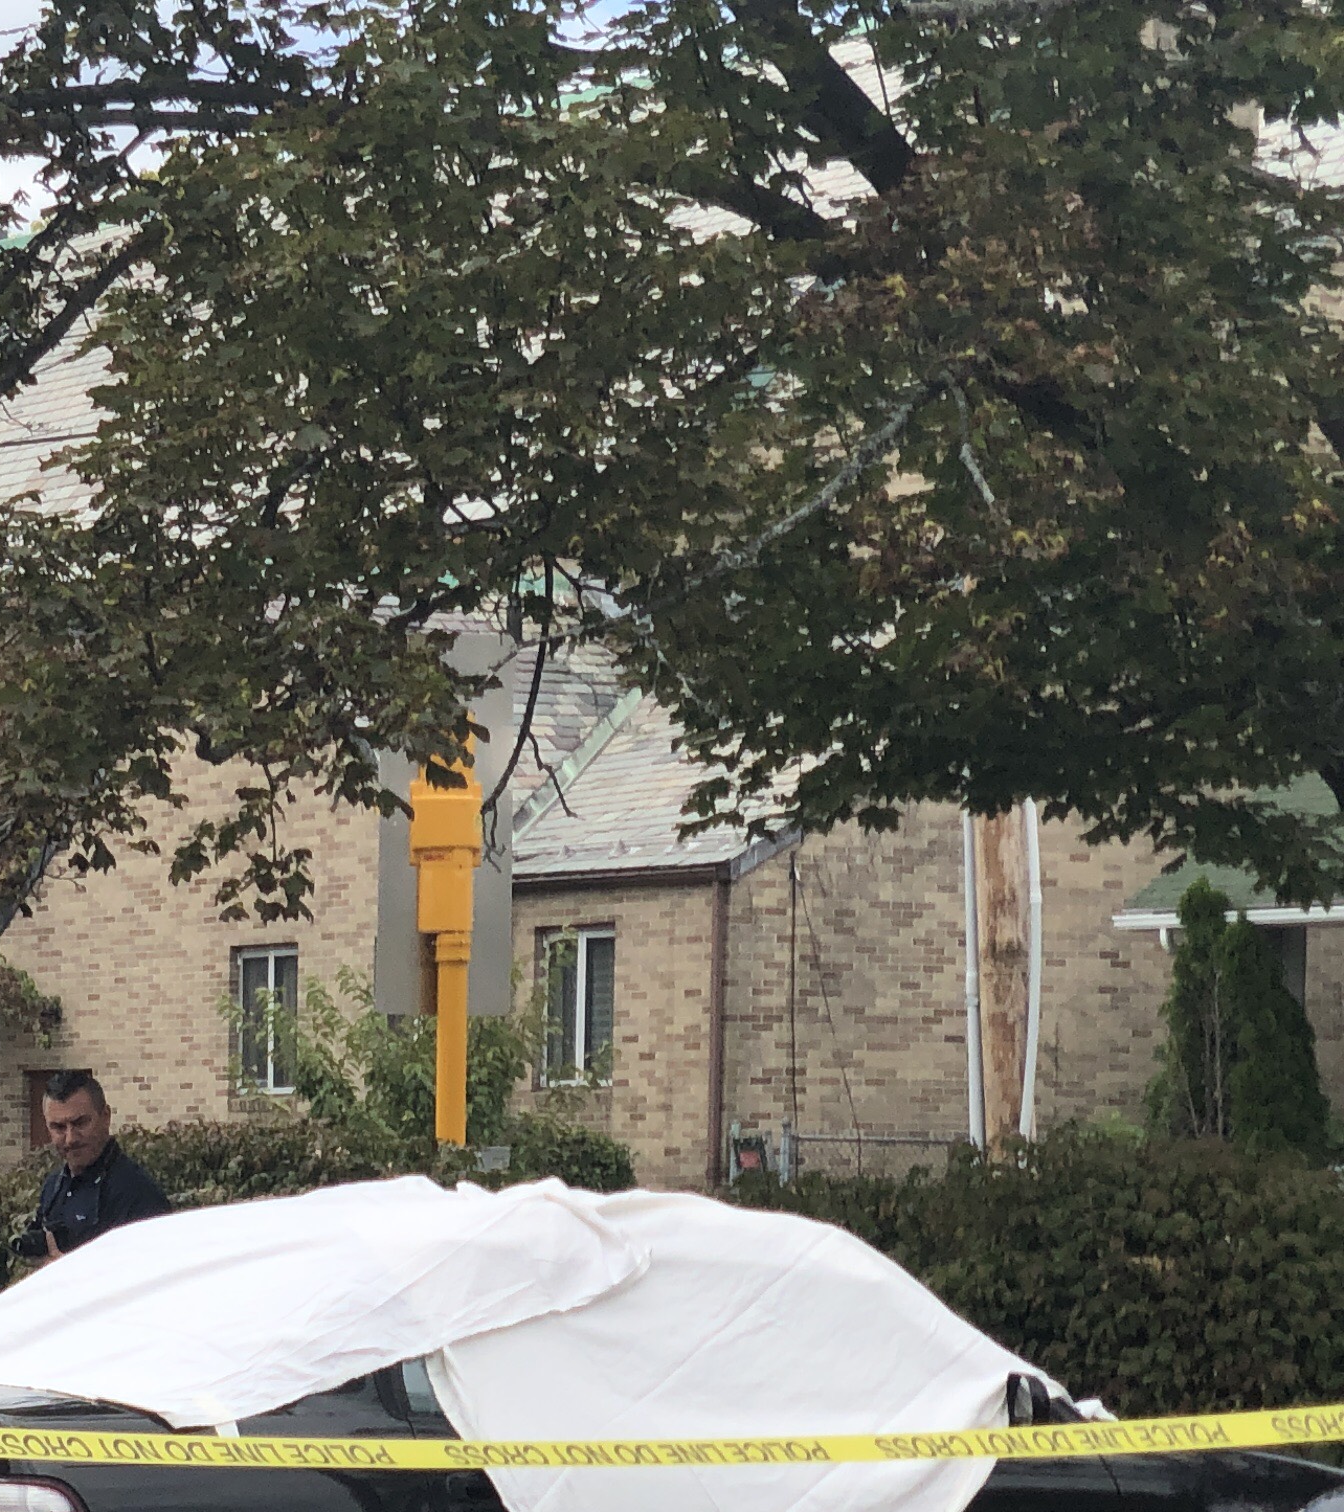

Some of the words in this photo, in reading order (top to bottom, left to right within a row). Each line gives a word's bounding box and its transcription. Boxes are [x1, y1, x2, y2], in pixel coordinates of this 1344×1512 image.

[1270, 1405, 1344, 1438] ROSS
[975, 1432, 1031, 1456] NOT
[1032, 1430, 1073, 1453] DO
[1073, 1427, 1137, 1451] LINE
[1136, 1420, 1231, 1448] POLICE
[98, 1436, 162, 1461] NOT
[163, 1440, 217, 1462] DO
[218, 1442, 281, 1464] LINE
[283, 1443, 398, 1467] POLICE
[443, 1444, 550, 1467] CROSS
[550, 1444, 614, 1466] NOT
[613, 1443, 663, 1465] DO
[665, 1442, 728, 1464] LINE
[723, 1439, 832, 1463] POLICE
[874, 1434, 974, 1460] CROSS
